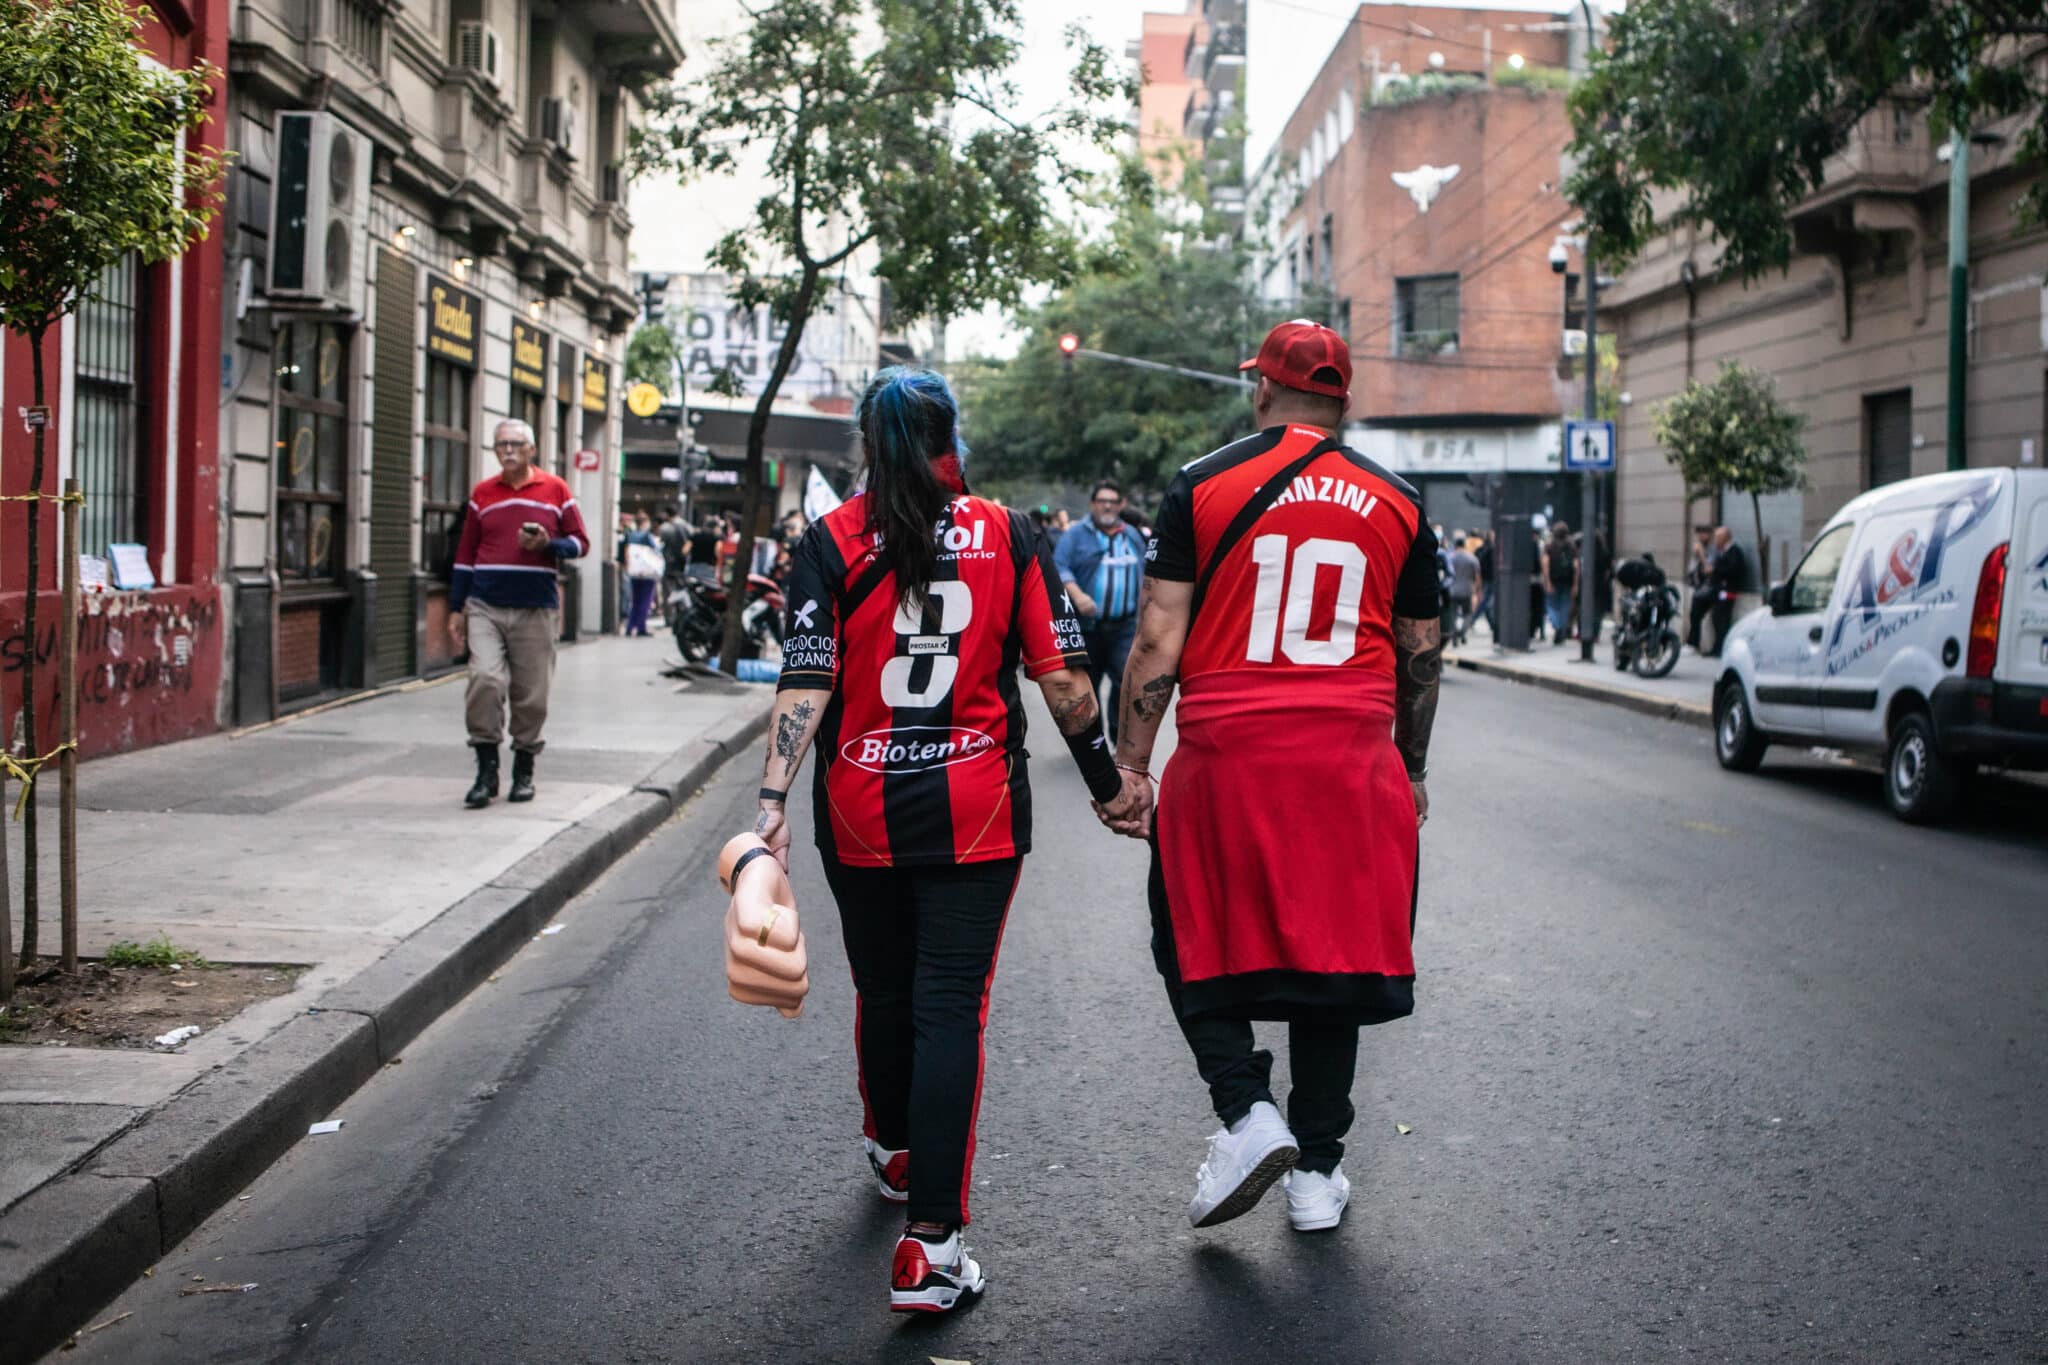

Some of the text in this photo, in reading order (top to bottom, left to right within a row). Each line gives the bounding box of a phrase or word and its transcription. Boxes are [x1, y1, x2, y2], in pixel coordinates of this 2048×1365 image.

[1254, 475, 1379, 519] ANZINI
[1245, 533, 1368, 666] 10
[789, 652, 837, 669] GRANOS
[880, 580, 973, 708] 8
[909, 642, 939, 650] PROSTAR
